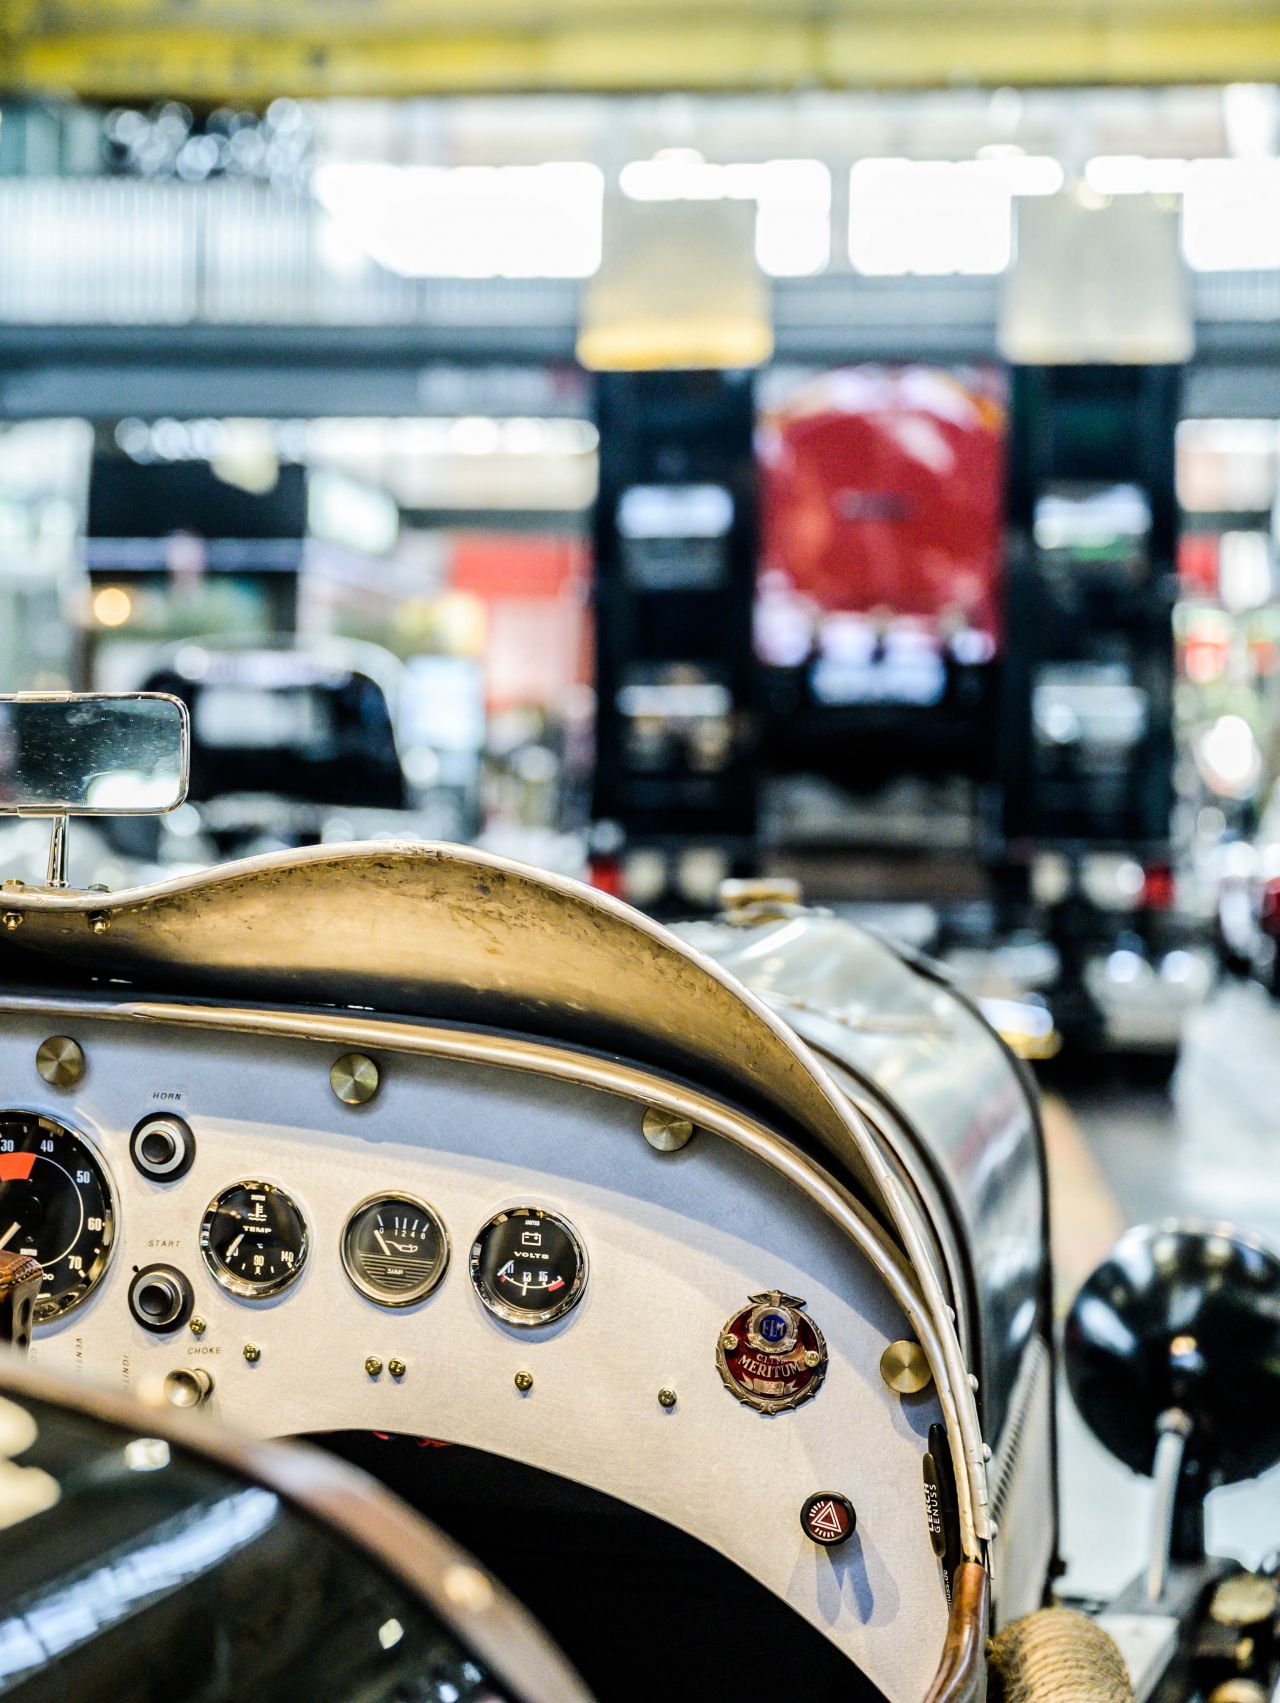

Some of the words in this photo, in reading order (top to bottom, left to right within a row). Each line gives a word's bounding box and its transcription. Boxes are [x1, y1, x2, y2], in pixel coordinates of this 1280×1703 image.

[152, 1092, 182, 1101] HORN
[0, 1139, 14, 1152] 30
[40, 1139, 54, 1152] 40
[76, 1171, 90, 1184] 50
[87, 1217, 102, 1231] 60
[242, 1225, 272, 1234] TEMP
[421, 1232, 426, 1240] 6
[148, 1239, 181, 1247] START
[253, 1255, 264, 1266] 90
[281, 1250, 294, 1262] 140
[513, 1251, 549, 1260] VOLTS
[68, 1256, 82, 1270] 70
[507, 1263, 514, 1274] 11
[522, 1271, 532, 1282] 13
[539, 1271, 548, 1282] 15
[187, 1347, 221, 1355] CHOKE
[738, 1354, 801, 1378] MERITUM
[929, 1484, 941, 1533] GENUSS
